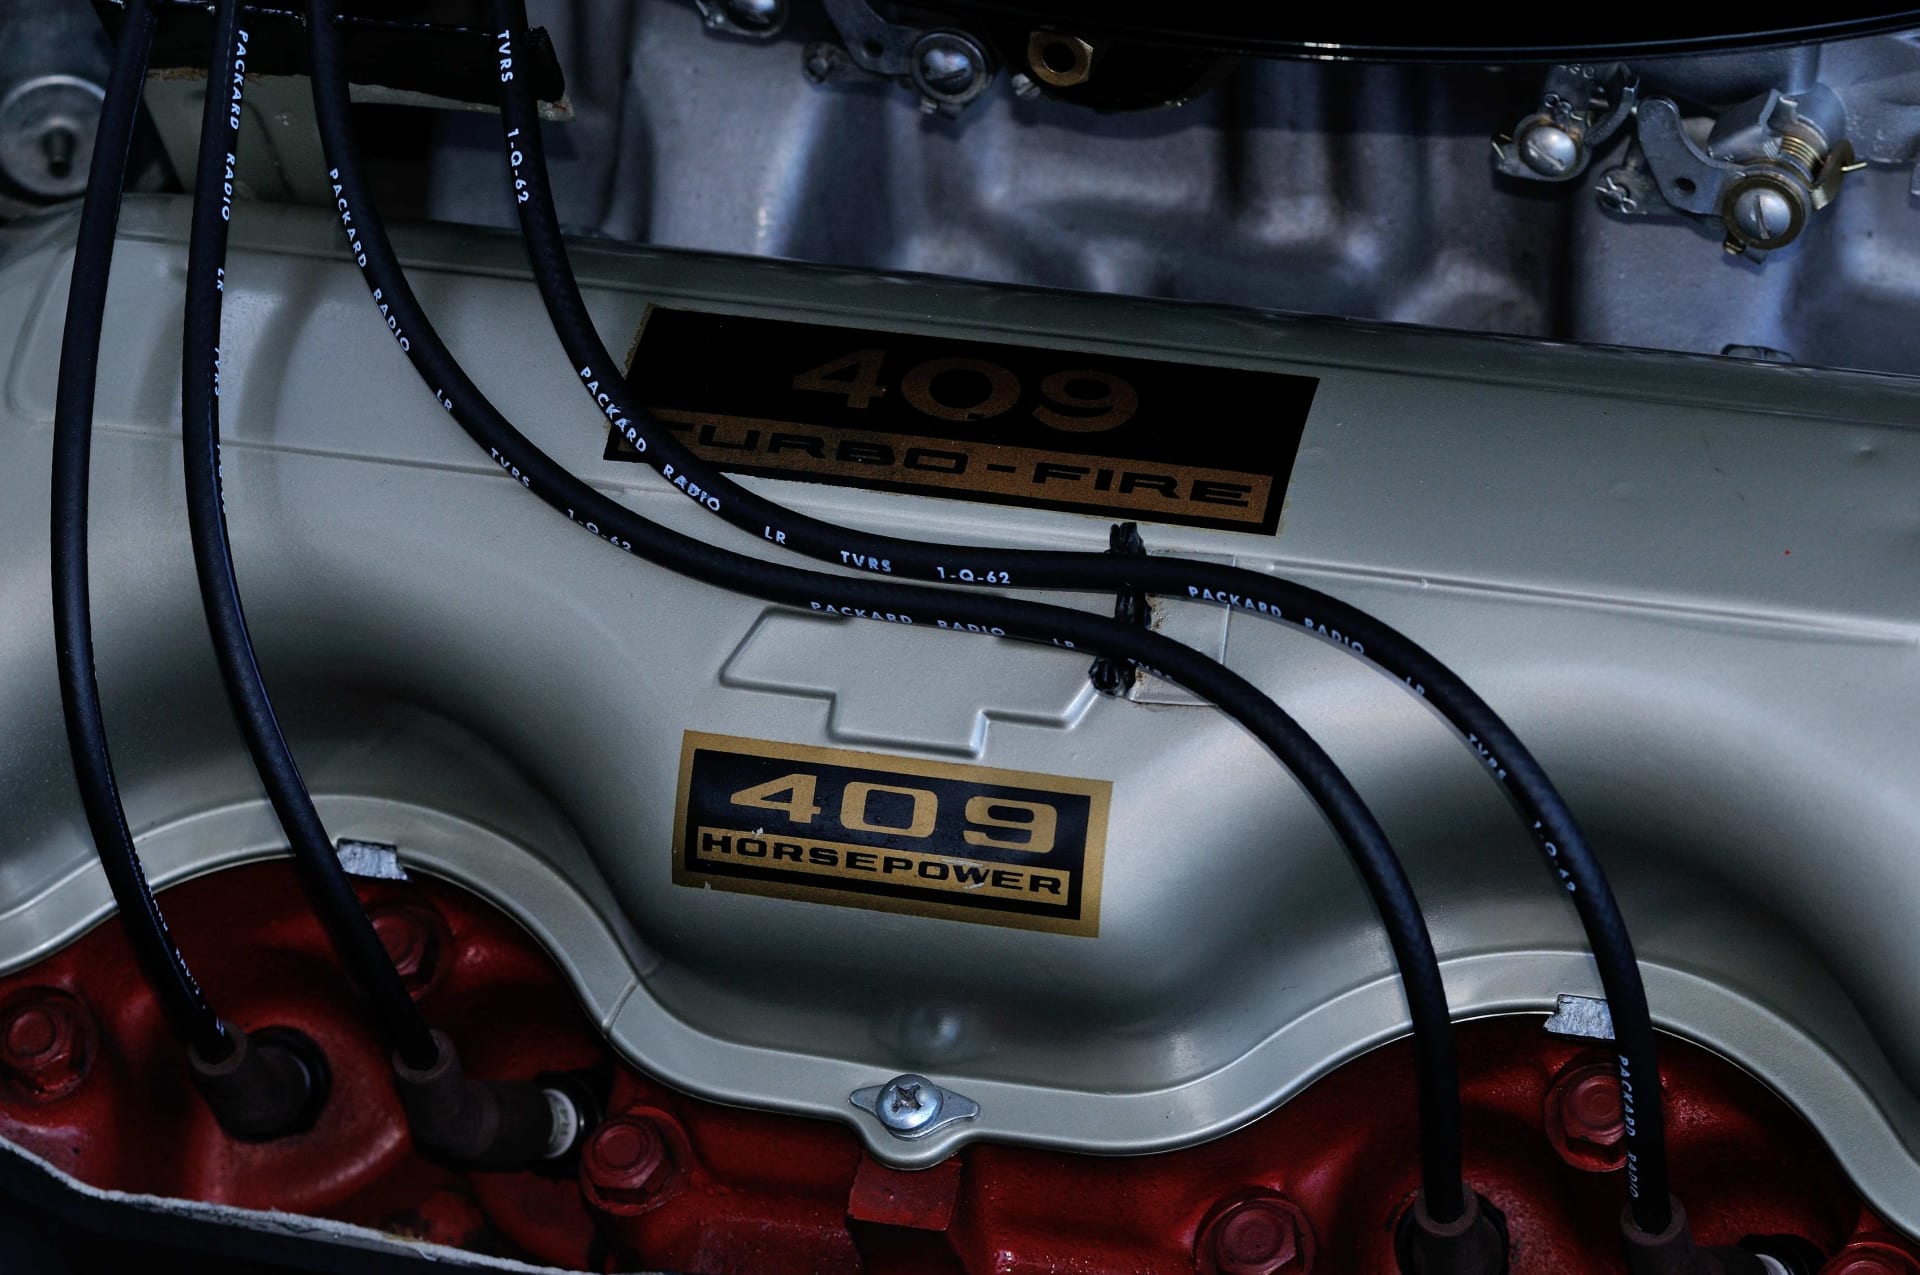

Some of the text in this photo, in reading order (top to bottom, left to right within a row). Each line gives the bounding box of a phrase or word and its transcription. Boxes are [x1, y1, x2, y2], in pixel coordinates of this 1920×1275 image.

[230, 29, 248, 130] PACKARD
[498, 29, 529, 204] TVRS 1-Q-62
[222, 152, 235, 221] RADIO
[329, 168, 632, 552] PACKARD RADIO LR TVRS 1-Q-62
[793, 349, 1138, 433] 409
[580, 366, 1011, 585] PACKARD RADIO LR TVRS 1-Q-62
[810, 600, 912, 624] PACKARD
[937, 619, 1006, 636] RADIO
[1187, 585, 1282, 618] PACKARD
[1303, 617, 1365, 654] RADIO
[730, 773, 1058, 854] 409
[701, 832, 1062, 896] HORSEPOWER
[1618, 1053, 1636, 1138] PACKARD
